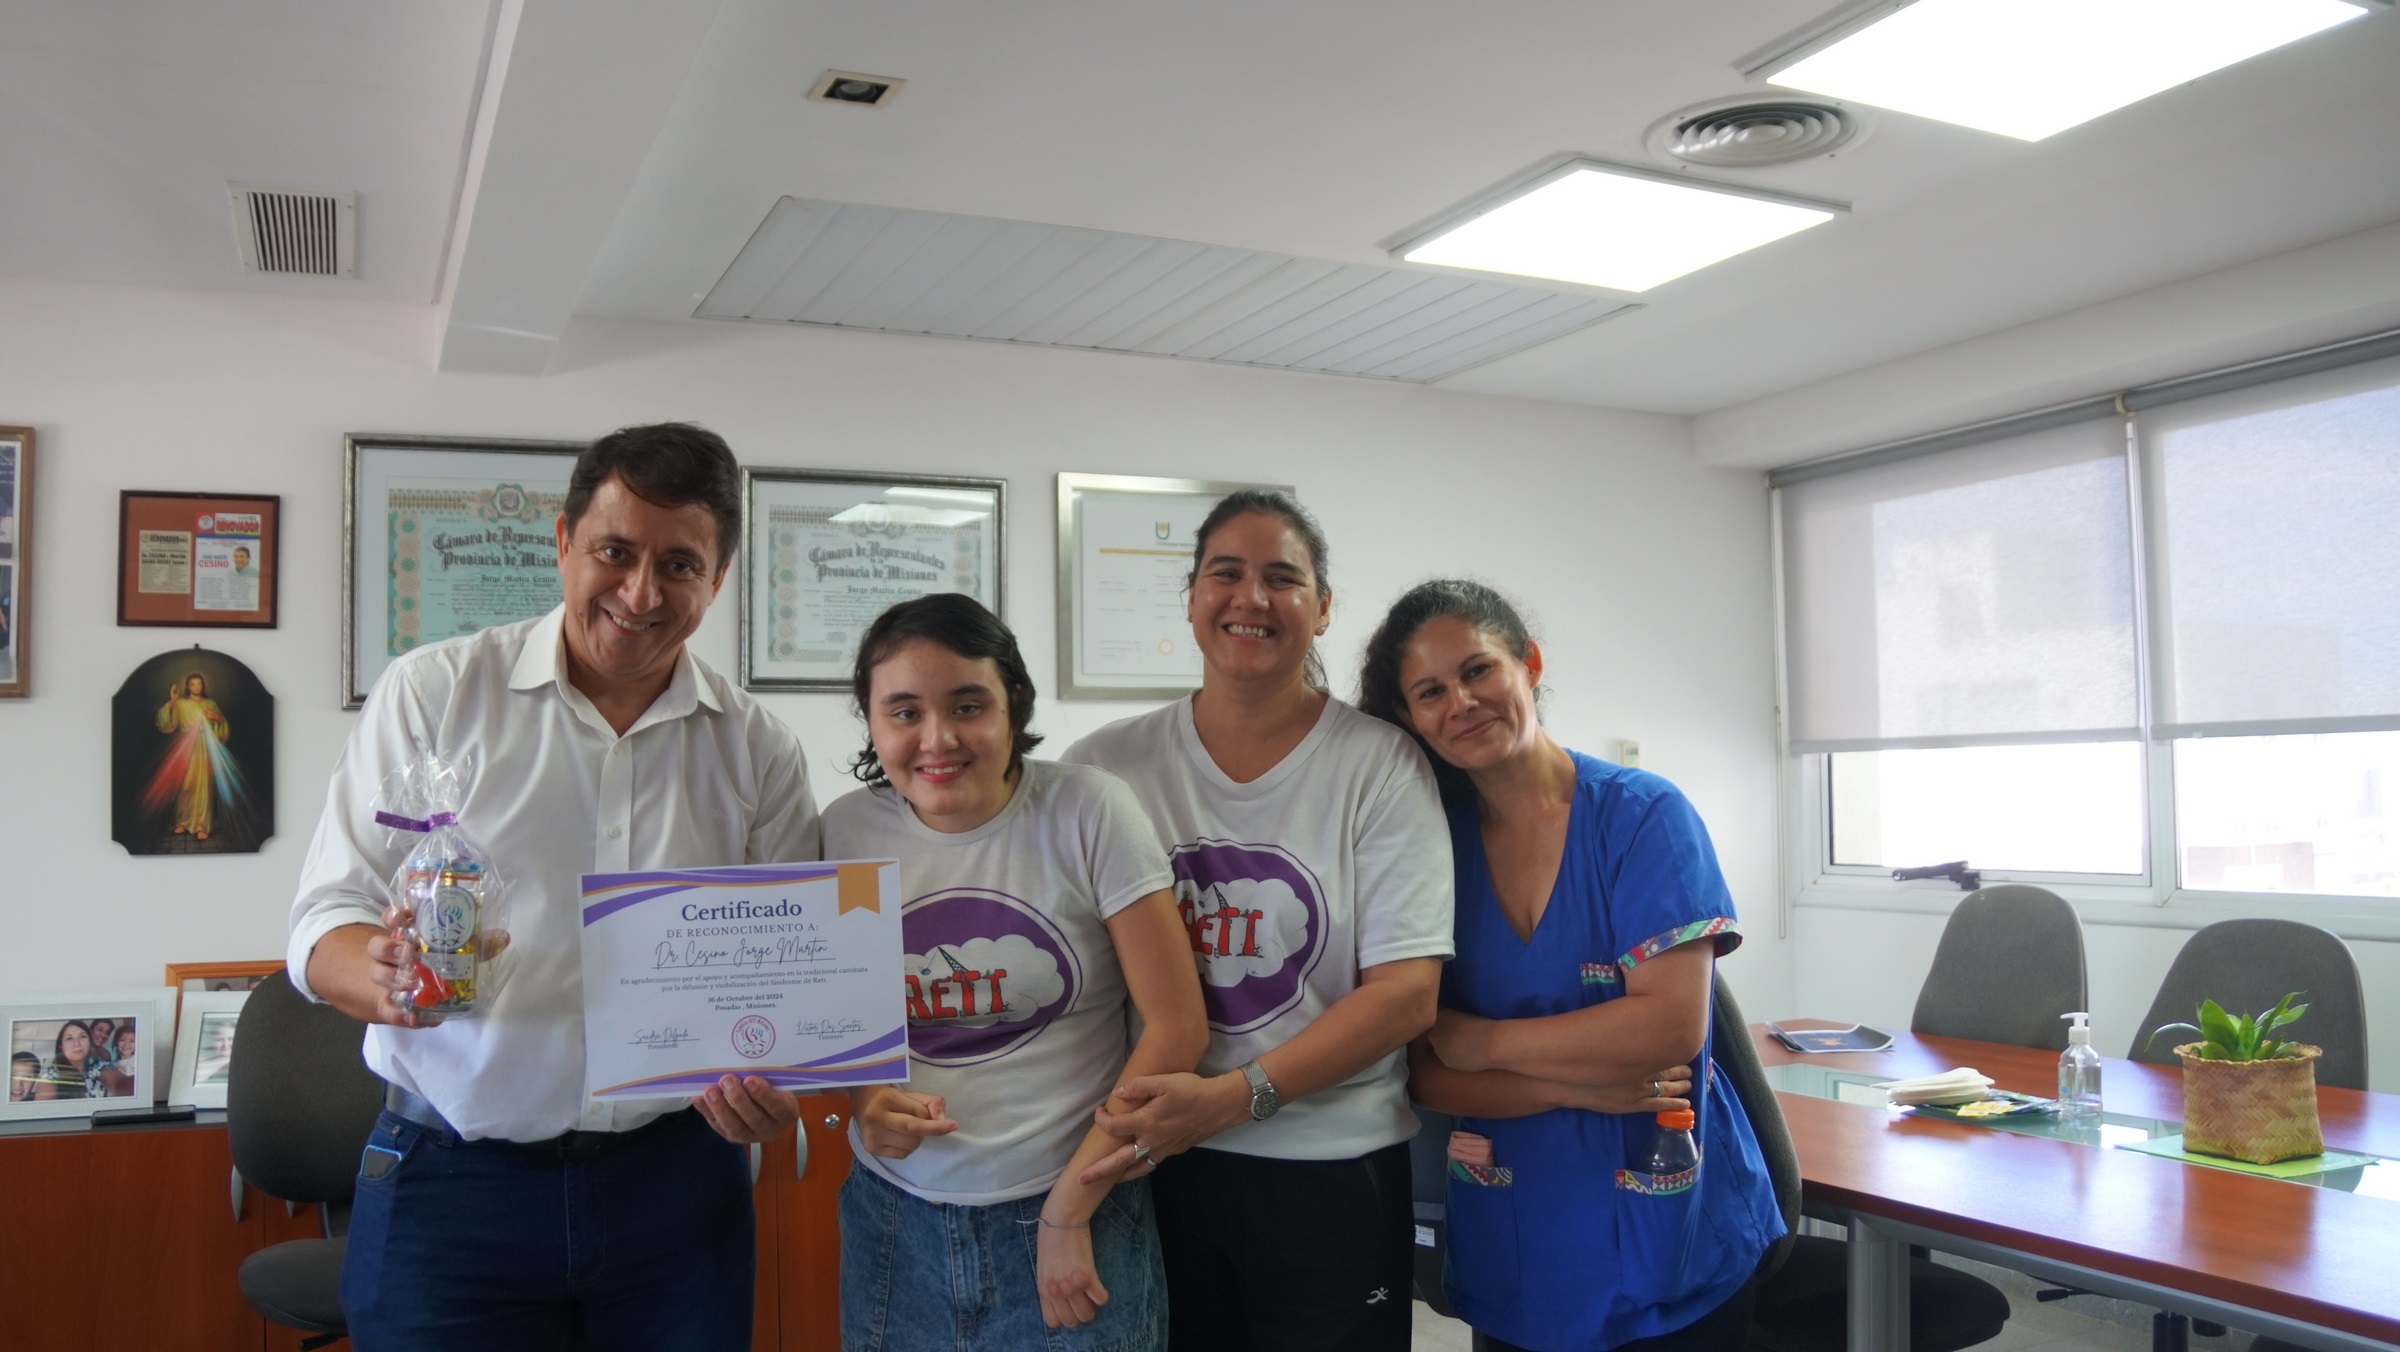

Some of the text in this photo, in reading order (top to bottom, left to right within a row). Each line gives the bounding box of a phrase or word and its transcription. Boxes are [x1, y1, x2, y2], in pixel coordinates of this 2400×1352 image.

[485, 527, 498, 543] de
[855, 541, 867, 557] de
[199, 560, 229, 568] CESINO
[440, 550, 502, 571] Provincia
[504, 552, 518, 566] de
[815, 563, 938, 583] Provincia de Misiones
[681, 899, 803, 922] Certificado
[666, 923, 820, 939] DE RECONOCIMIENTO A:
[685, 939, 729, 967] Cesino
[733, 938, 774, 969] Jorge
[631, 976, 681, 985] agradecimiento
[803, 968, 838, 976] tradicional
[715, 1003, 742, 1011] Posadas
